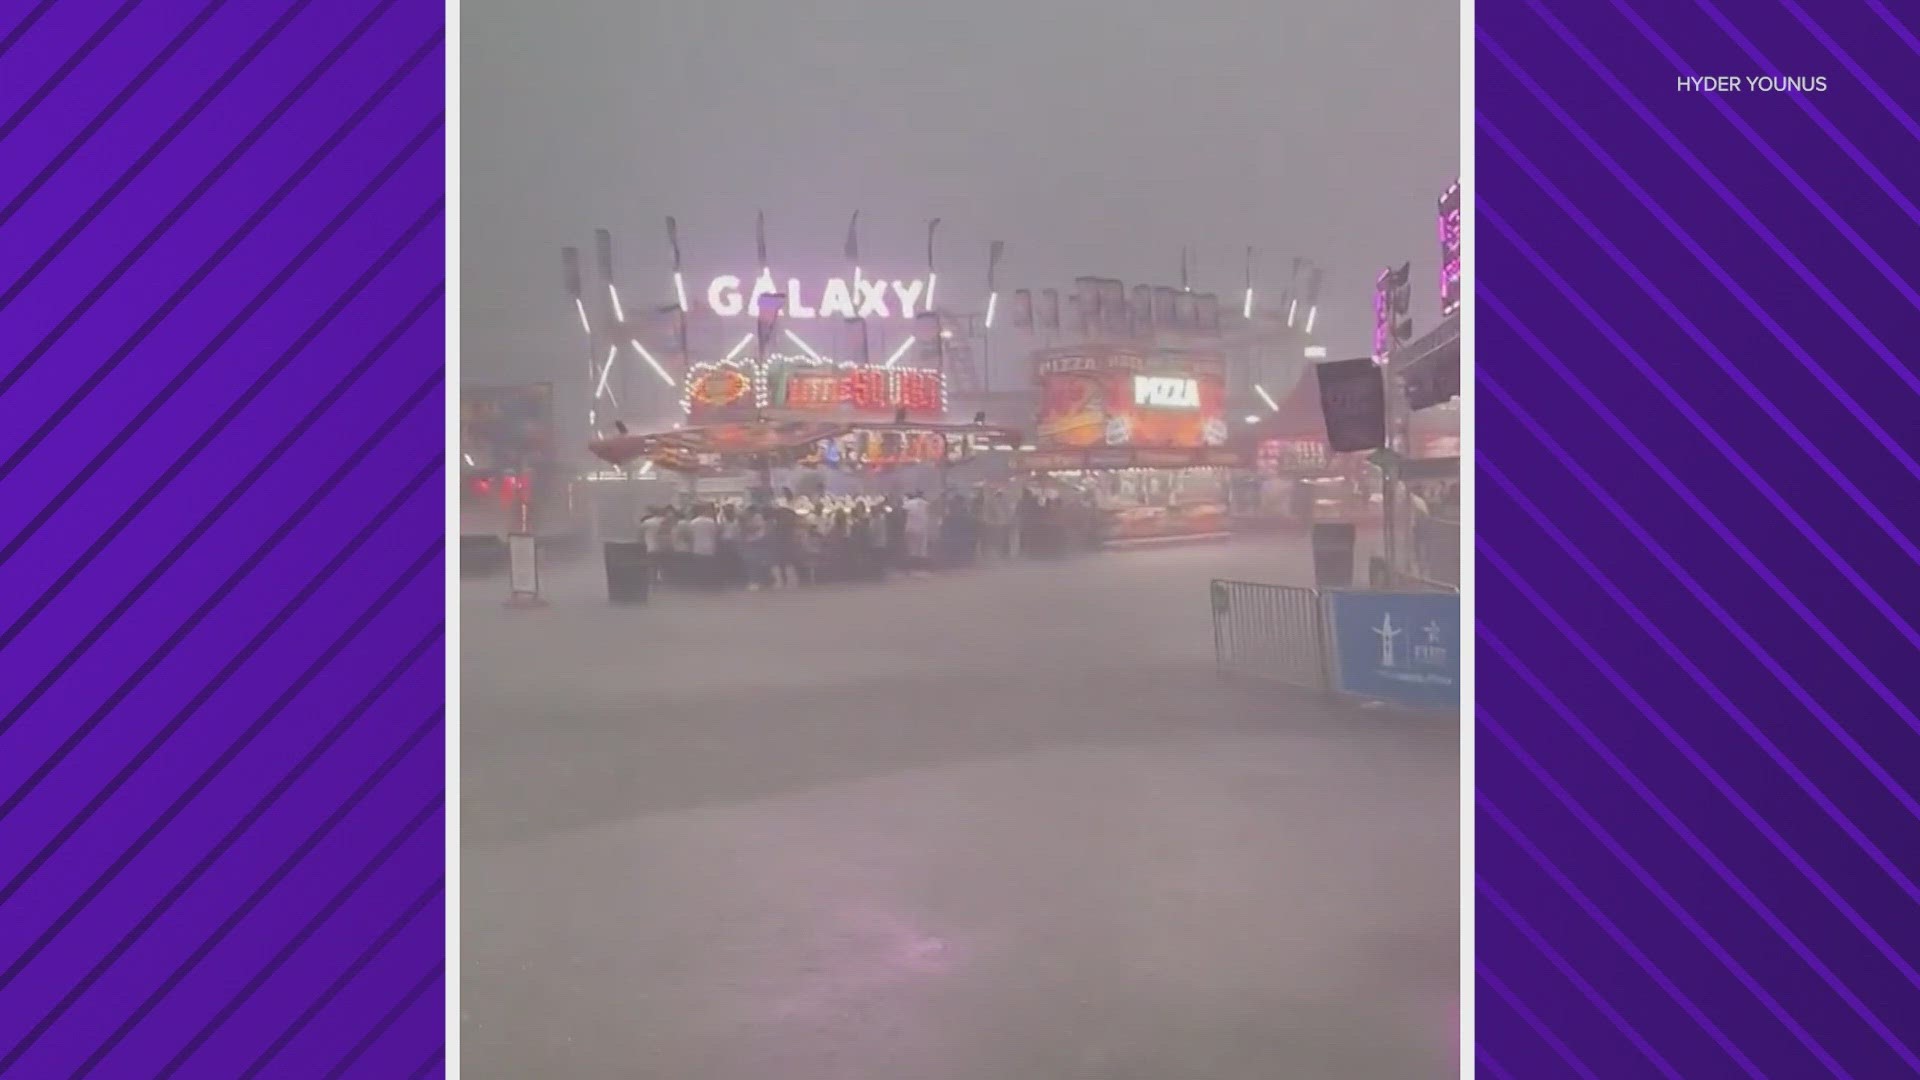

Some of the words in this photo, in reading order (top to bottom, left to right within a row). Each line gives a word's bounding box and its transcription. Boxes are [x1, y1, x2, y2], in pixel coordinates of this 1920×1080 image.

[707, 274, 924, 319] GALAXY
[1039, 357, 1097, 376] PIZZA
[1134, 374, 1202, 408] PIZZA
